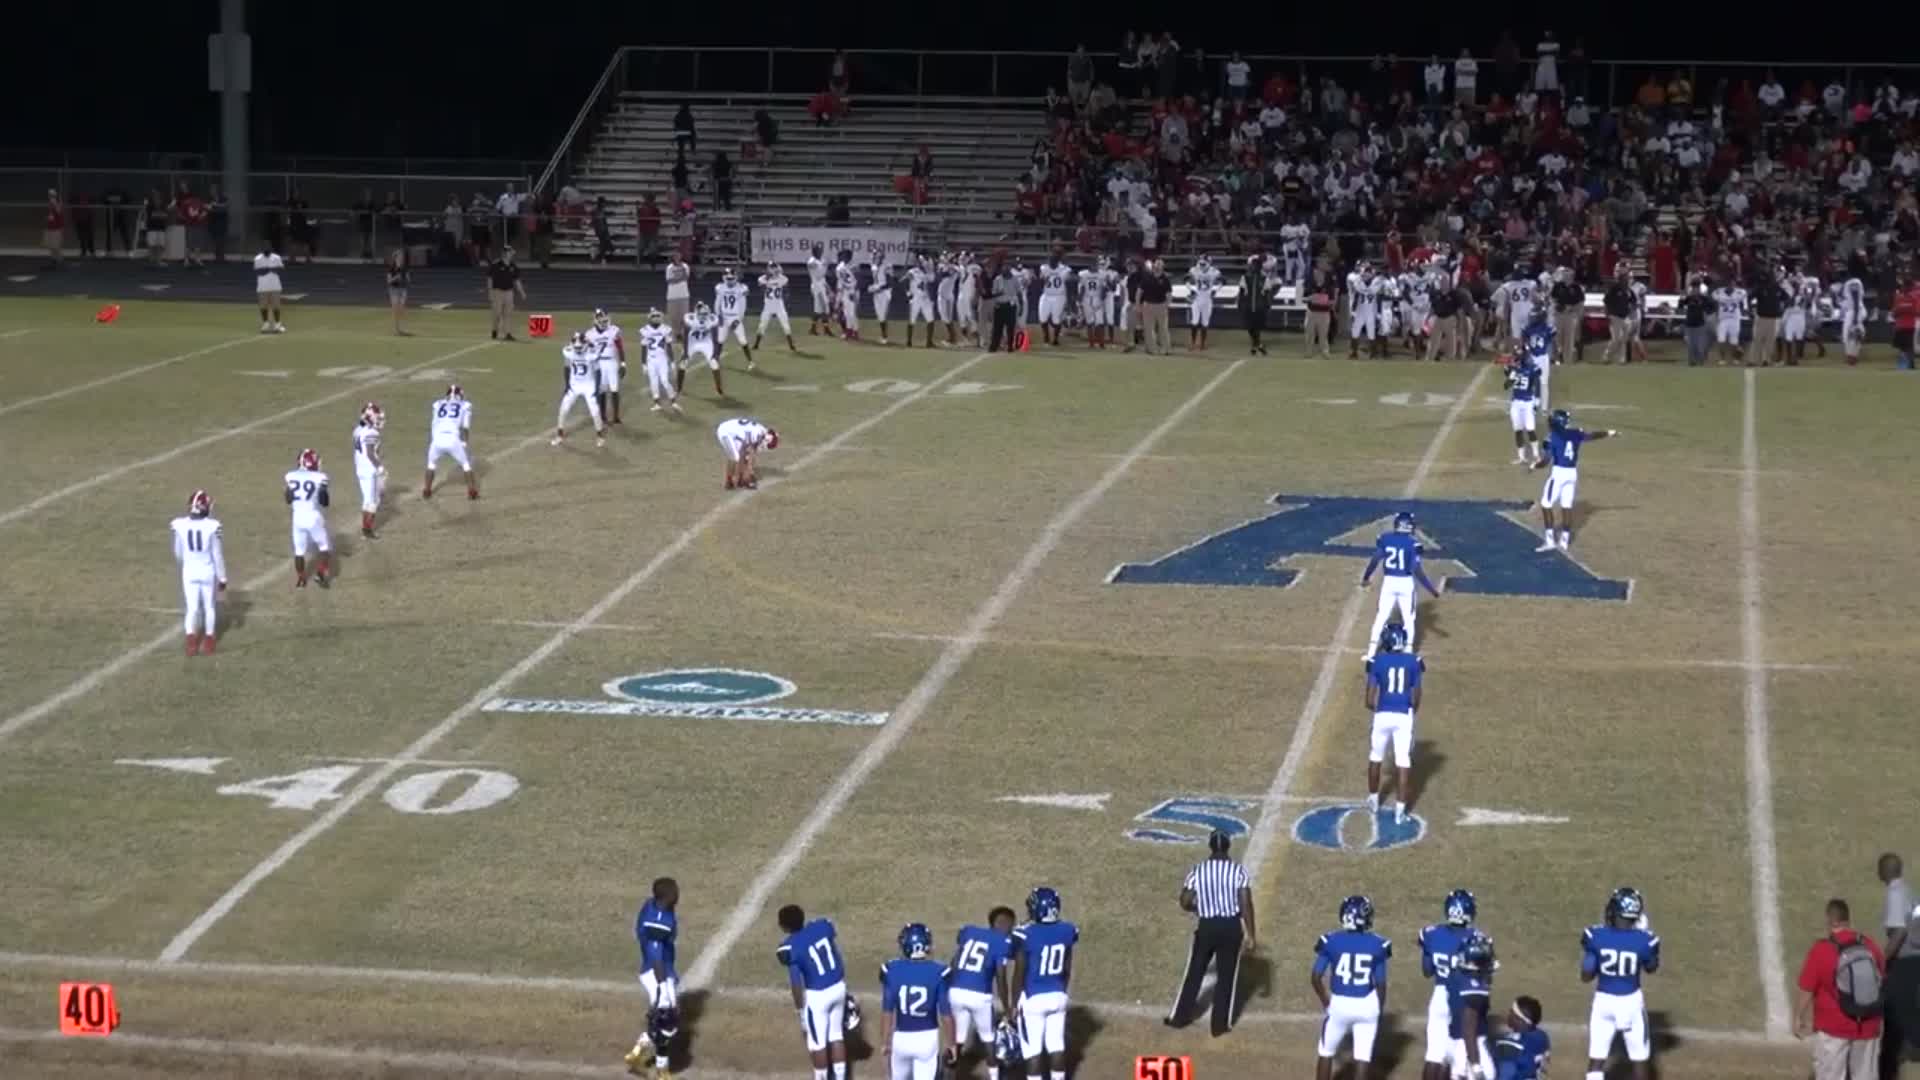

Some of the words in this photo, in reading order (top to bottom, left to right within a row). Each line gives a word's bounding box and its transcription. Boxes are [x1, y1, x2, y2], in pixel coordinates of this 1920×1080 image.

[761, 238, 794, 250] HHS
[829, 239, 862, 250] RED
[867, 239, 906, 252] Band
[724, 295, 736, 309] 19
[1511, 287, 1529, 302] 69
[529, 317, 549, 333] 30
[572, 363, 588, 376] 13
[438, 402, 461, 418] 63
[1564, 440, 1575, 461] 4
[289, 480, 316, 501] 29
[187, 529, 203, 552] 11
[1107, 494, 1635, 602] A
[1385, 546, 1405, 570] 21
[1387, 667, 1405, 694] 11
[216, 764, 521, 815] 40
[1122, 797, 1427, 852] 50
[808, 936, 836, 977] 17
[958, 938, 989, 973] 15
[1039, 943, 1066, 976] 10
[1600, 948, 1638, 977] 20
[1335, 952, 1373, 985] 45
[65, 985, 105, 1027] 40
[899, 984, 928, 1017] 12
[1141, 1056, 1184, 1080] 50
